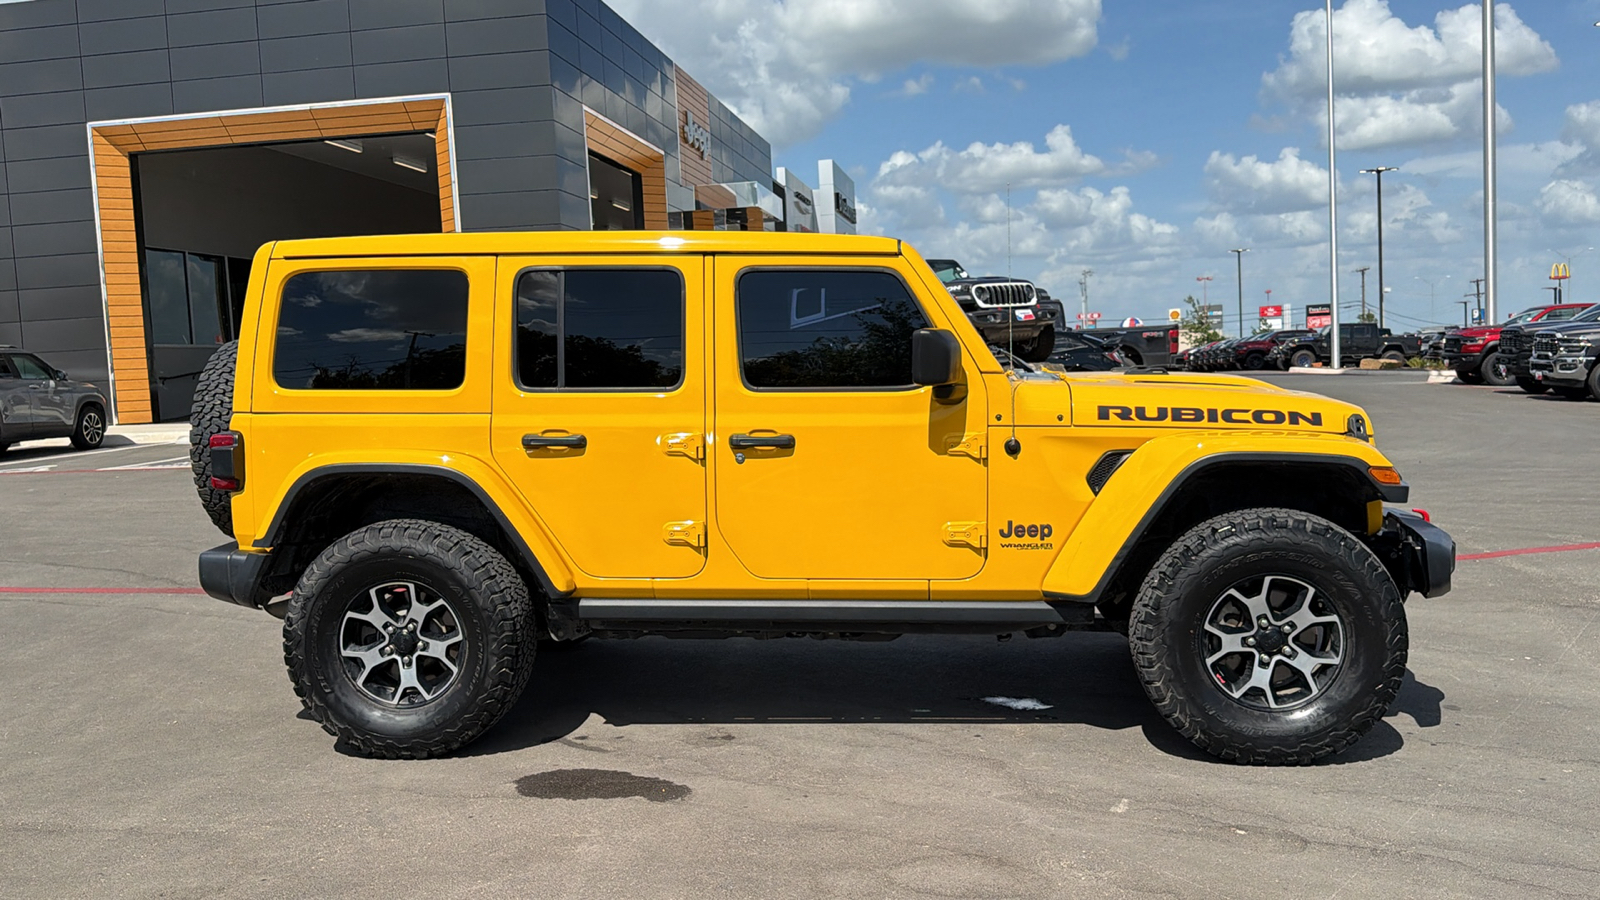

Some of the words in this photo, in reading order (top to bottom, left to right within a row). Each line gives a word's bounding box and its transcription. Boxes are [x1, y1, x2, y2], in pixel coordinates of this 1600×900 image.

[684, 111, 711, 160] Jeep
[1097, 405, 1323, 427] RUBICON
[999, 520, 1053, 541] Jeep
